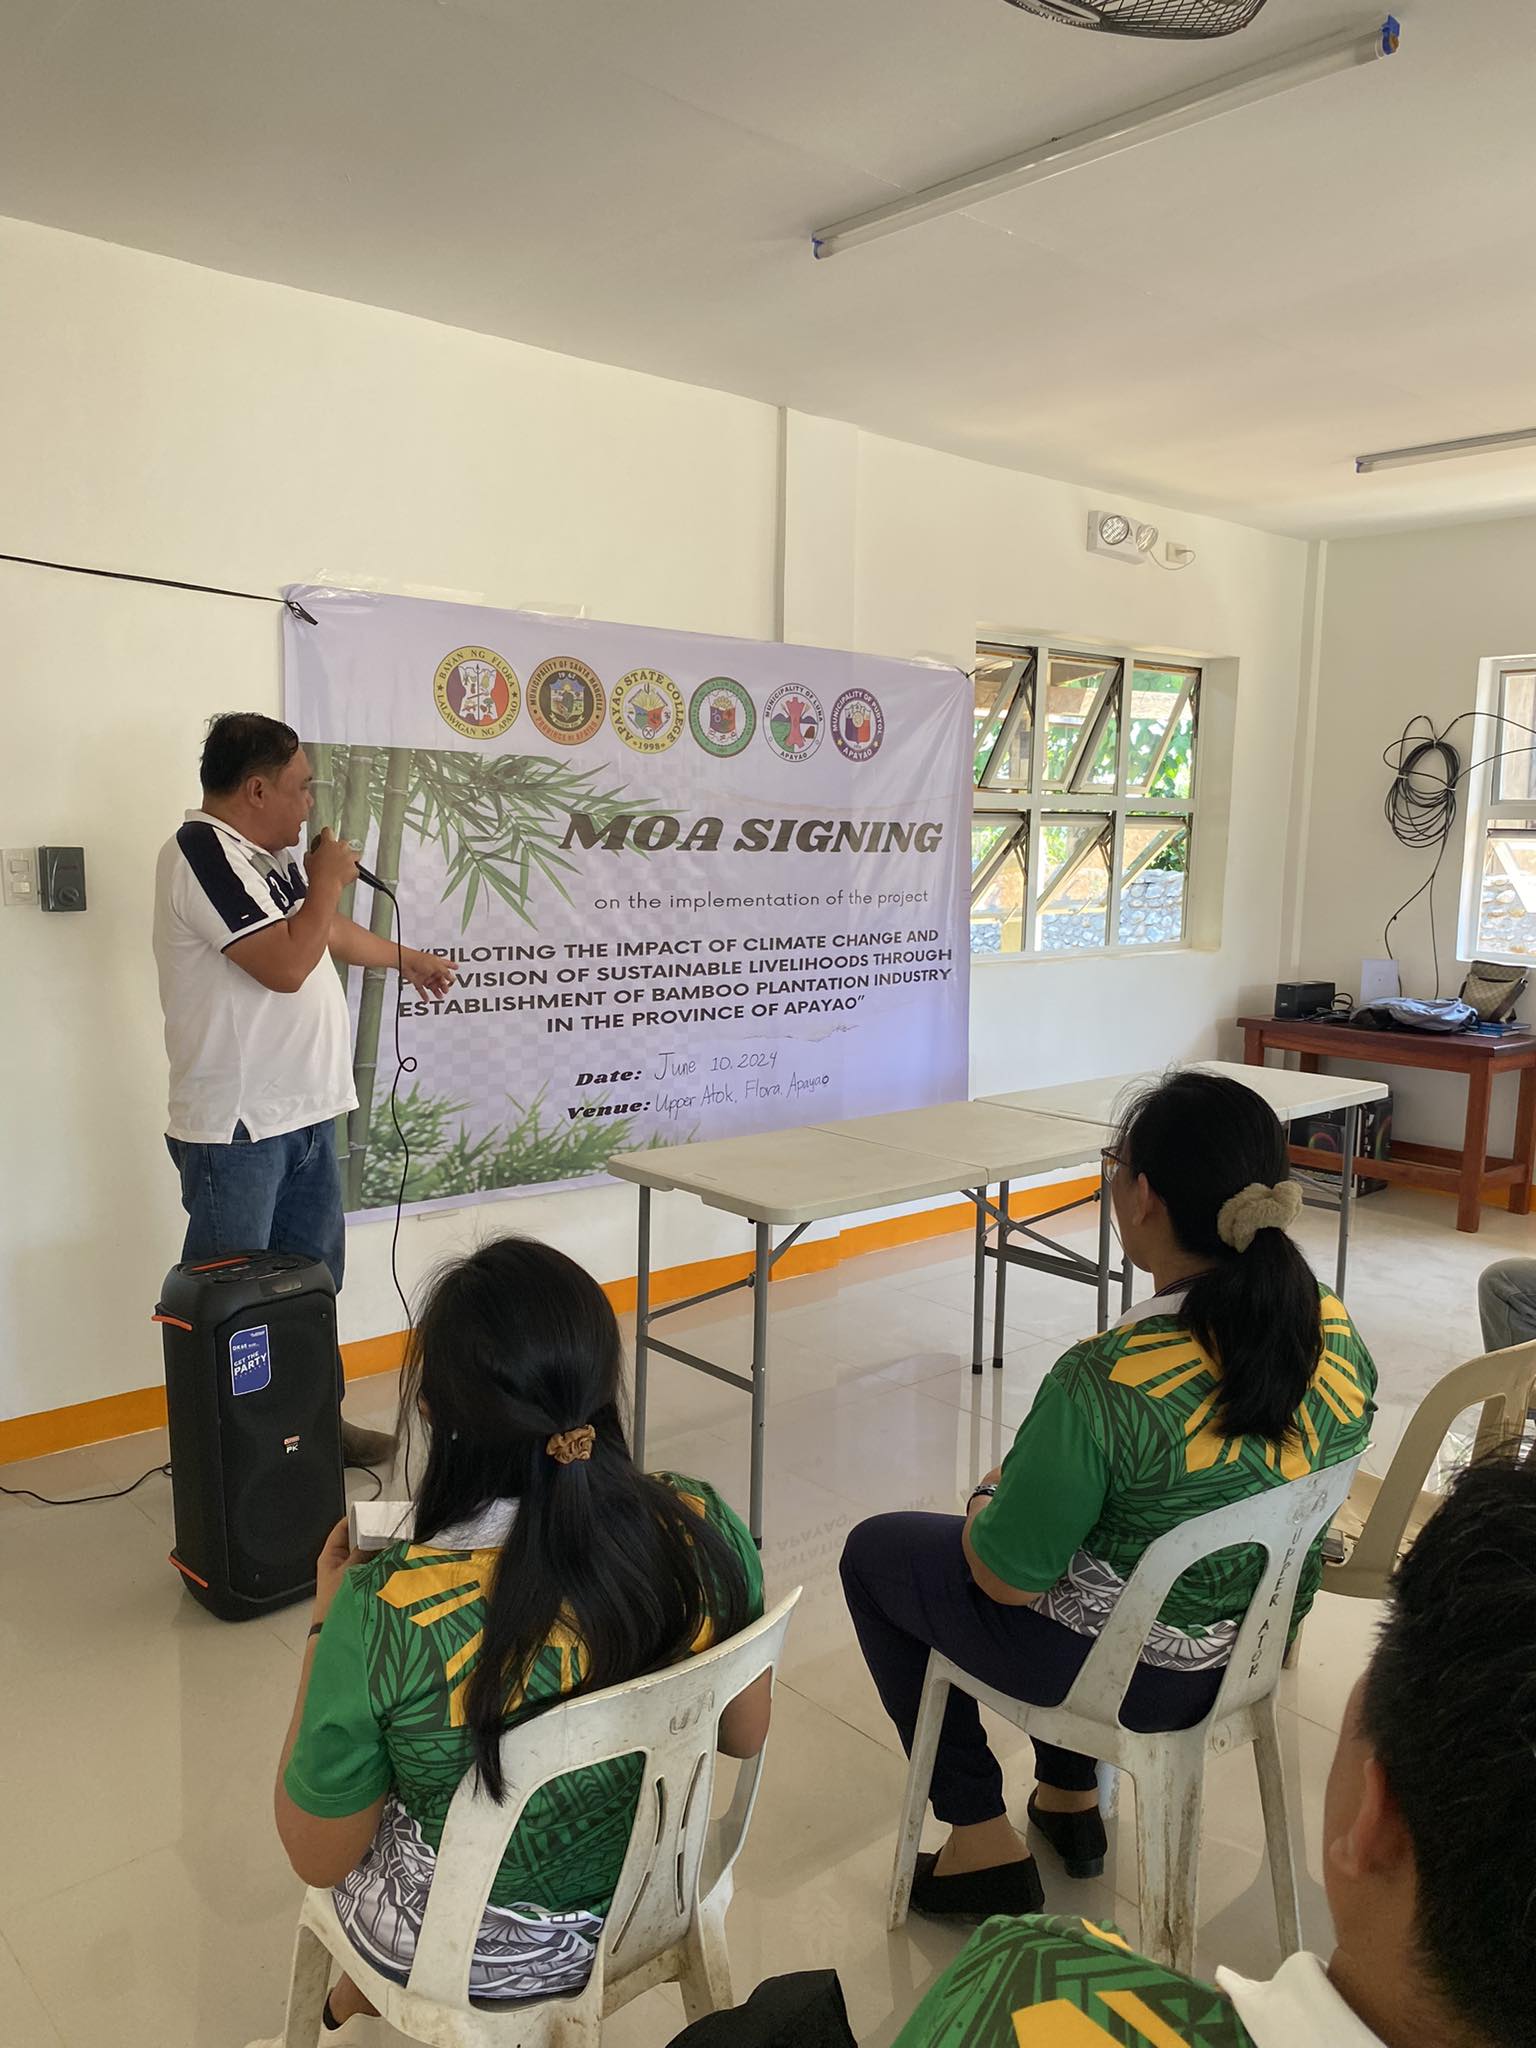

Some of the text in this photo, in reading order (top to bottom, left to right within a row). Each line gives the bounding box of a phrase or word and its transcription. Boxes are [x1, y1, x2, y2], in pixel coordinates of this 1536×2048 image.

[439, 649, 515, 687] BAYAN NG FLORA
[530, 662, 557, 705] MUNICIPALITY
[437, 694, 518, 736] LALAWIGAN NG APAYAO
[612, 686, 634, 741] APAYAO
[624, 670, 664, 687] STATE
[666, 682, 684, 743] COLLEGE
[765, 686, 824, 722] MUNICIPALITY OF LUNA
[832, 690, 883, 734] MUNICIPALITY OF PUDTOL
[780, 751, 808, 760] APAYAO
[843, 747, 873, 760] APAYAO
[558, 813, 944, 853] MOA SIGNING
[594, 889, 928, 912] on the implementation of the project
[564, 942, 608, 959] THE
[616, 939, 702, 957] IMPACT
[708, 938, 737, 954] OF
[743, 935, 827, 951] CLIMATE
[832, 930, 902, 948] CHANGE
[906, 929, 939, 943] AND
[398, 949, 952, 992] PVISION OF SUSTAINABLE LIVELIHOODS THROUGH
[399, 967, 952, 1018] ESTABLISHMENT OF BAMBOO PLANTATION INDUSTRY
[547, 1017, 573, 1033] IN
[581, 1014, 625, 1030] THE
[632, 1005, 745, 1027] PROVINCE
[751, 1003, 779, 1018] OF
[575, 1070, 642, 1087] Date:
[654, 1051, 697, 1080] June
[567, 1101, 651, 1120] Venue:
[655, 1093, 697, 1121] Upper
[785, 1071, 830, 1099] Apayao
[234, 1352, 267, 1376] PARTY
[1269, 1527, 1303, 1607] UPPER
